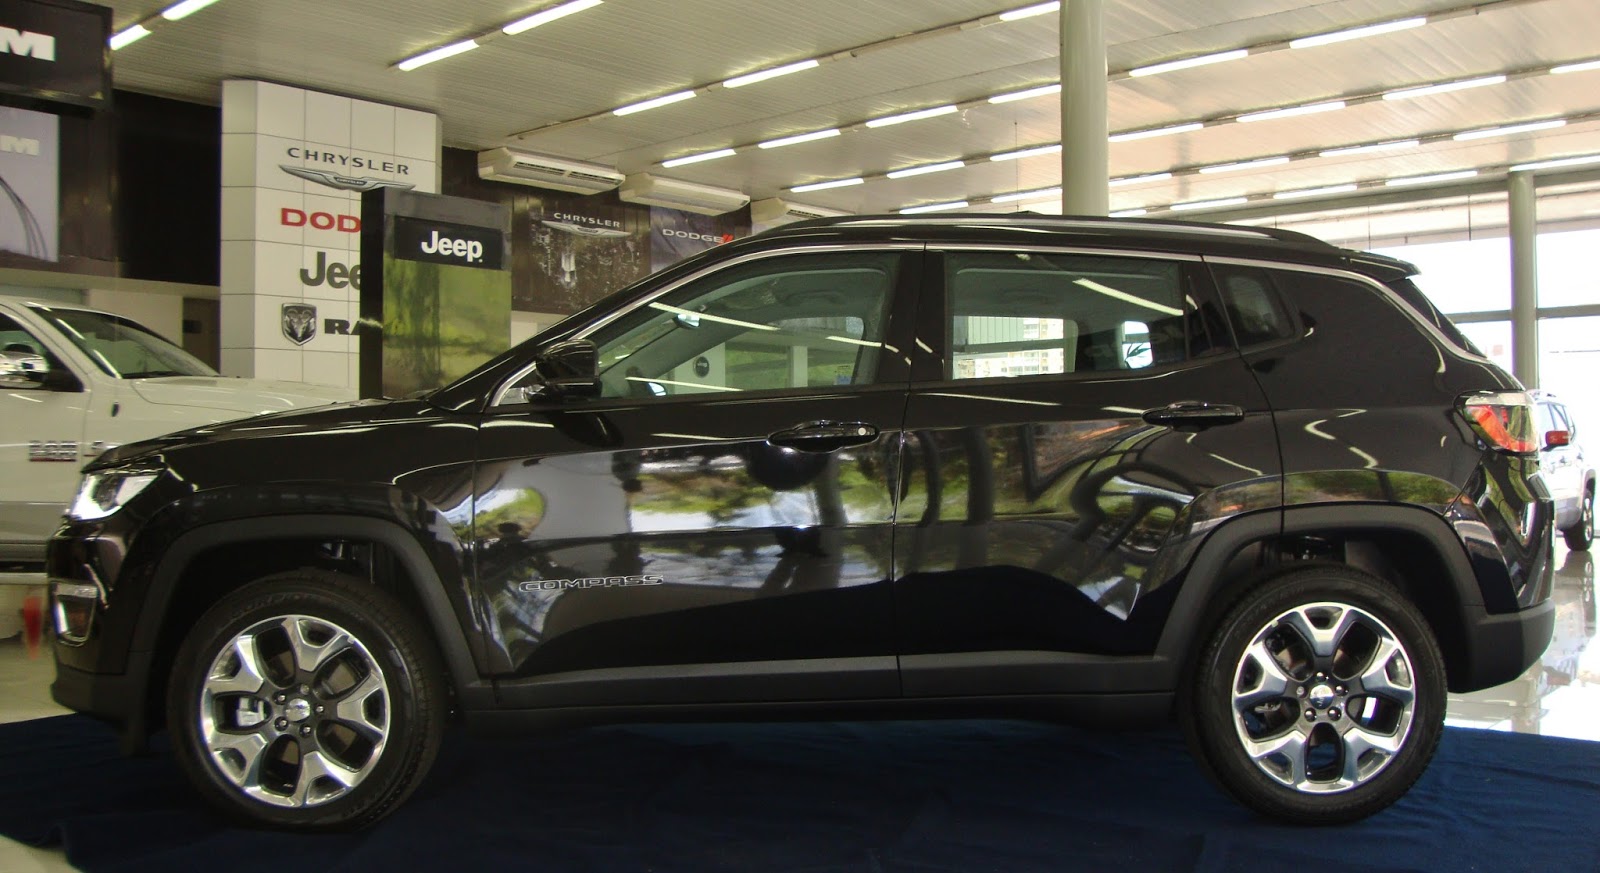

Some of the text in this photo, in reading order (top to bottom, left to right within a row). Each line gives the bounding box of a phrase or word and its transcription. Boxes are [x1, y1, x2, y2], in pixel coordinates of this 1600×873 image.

[287, 147, 410, 175] CHRYSLER
[281, 208, 361, 233] DOD
[553, 212, 621, 228] CHRYSLER
[662, 228, 724, 244] DODGE
[518, 574, 664, 592] COMPASS
